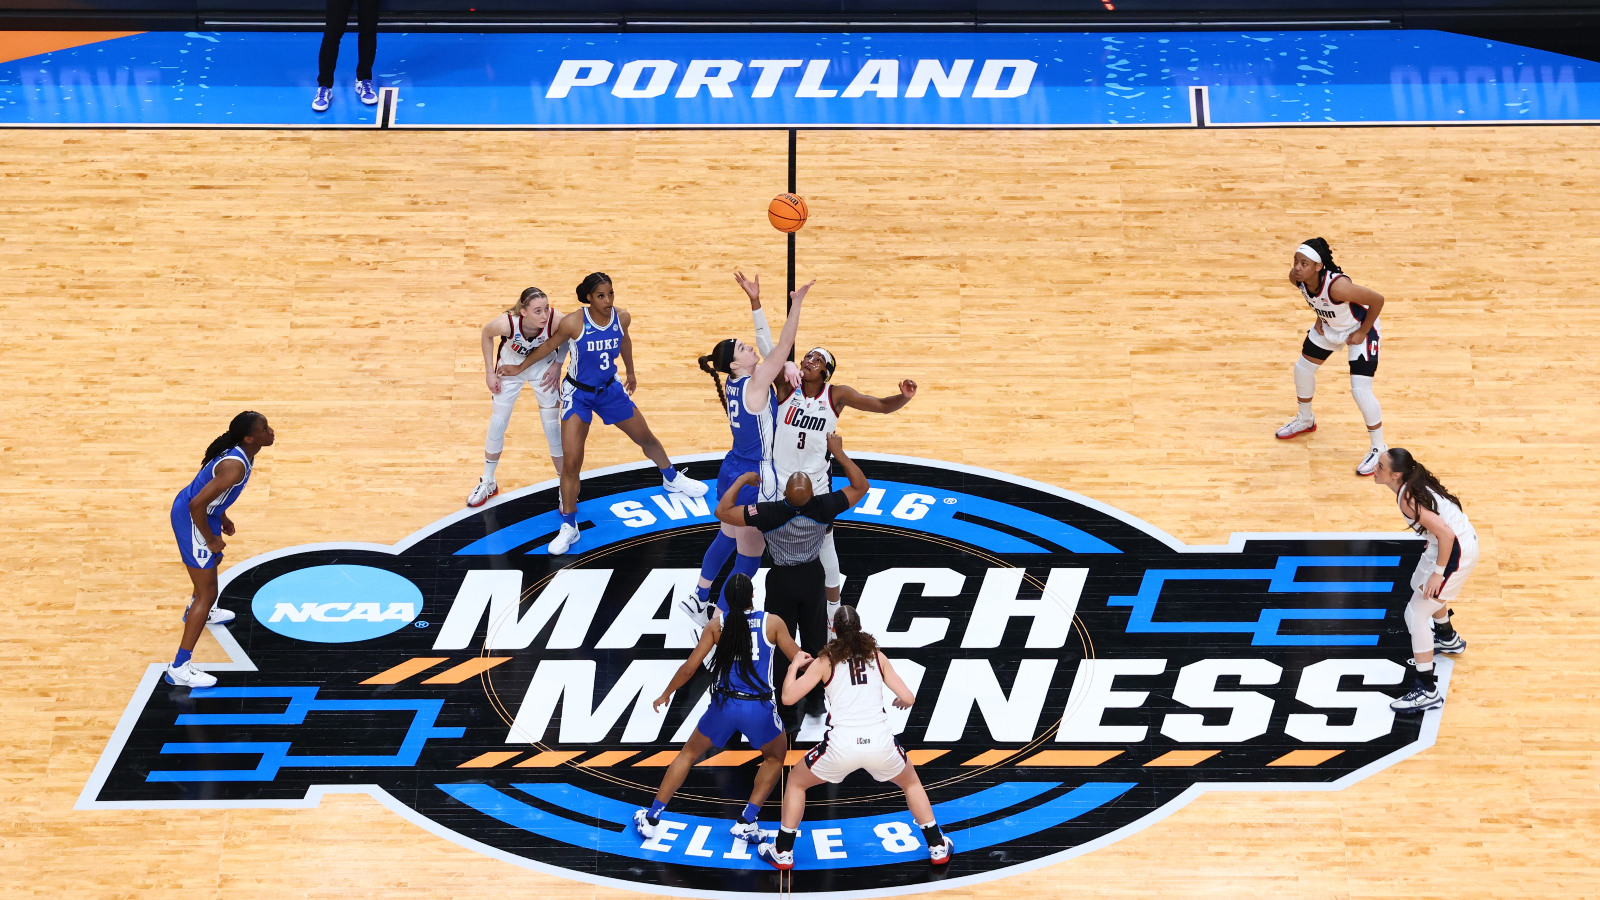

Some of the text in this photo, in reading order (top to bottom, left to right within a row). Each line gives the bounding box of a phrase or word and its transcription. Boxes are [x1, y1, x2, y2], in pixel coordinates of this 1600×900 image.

[545, 59, 1038, 98] PORTLAND
[587, 338, 619, 352] DUKE
[600, 352, 610, 370] 3
[784, 406, 826, 431] UConn
[797, 432, 806, 449] 3
[268, 603, 415, 623] NCAA
[432, 568, 1088, 649] MACH
[847, 658, 868, 686] 12
[505, 658, 1406, 743] MNESS
[873, 821, 921, 853] 8
